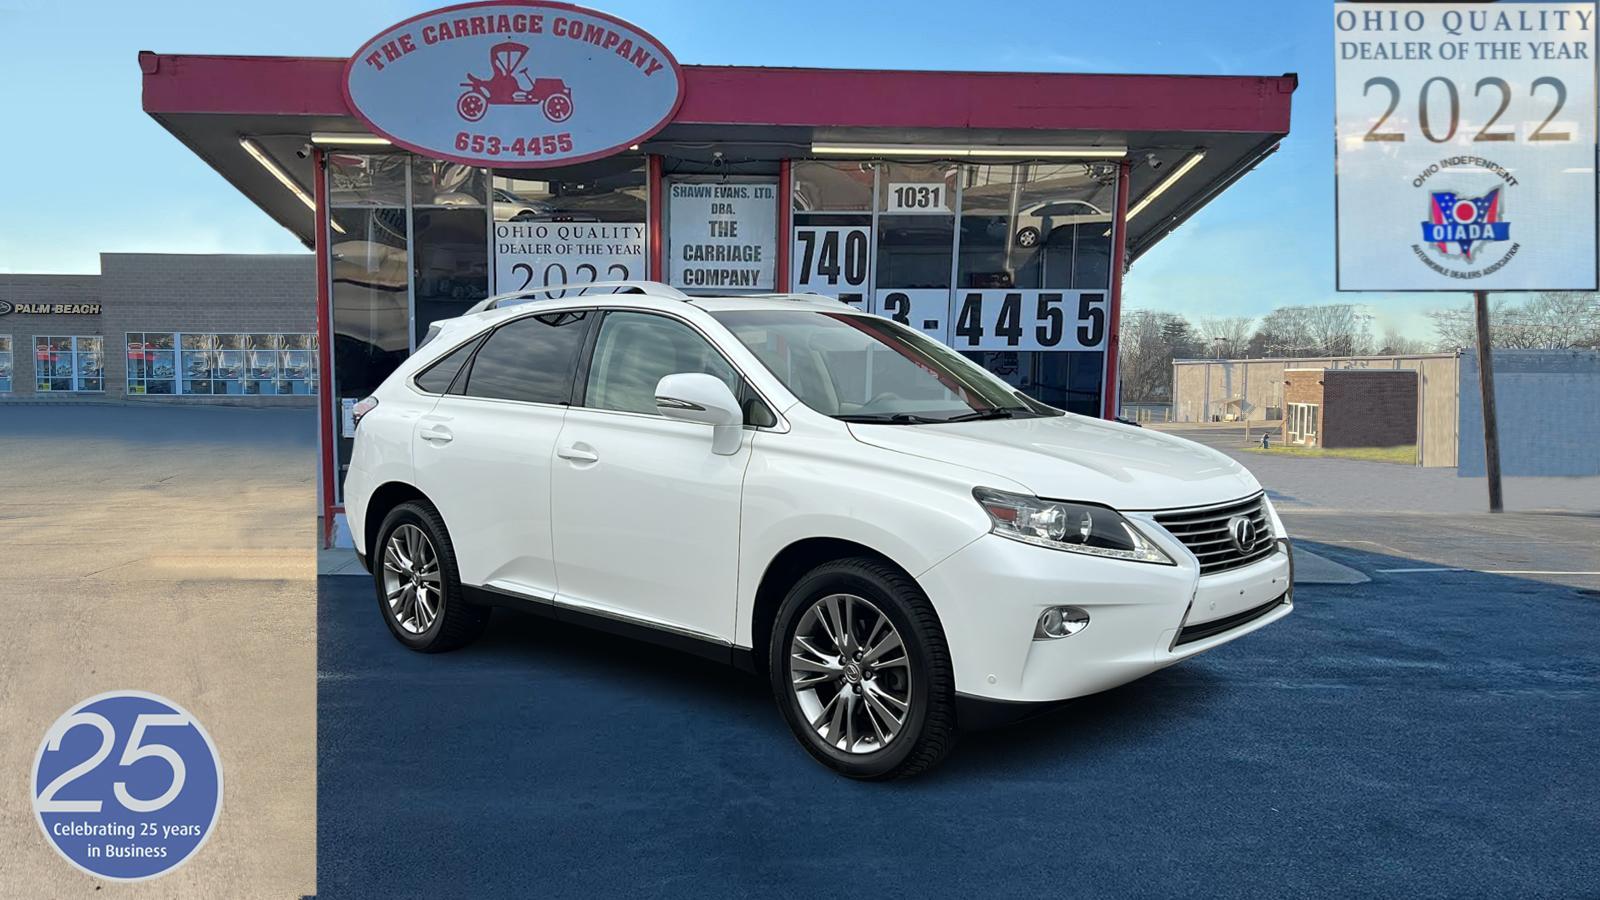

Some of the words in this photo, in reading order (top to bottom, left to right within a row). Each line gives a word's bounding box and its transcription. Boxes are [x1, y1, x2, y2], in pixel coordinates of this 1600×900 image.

[1336, 10, 1425, 31] OHIO
[1442, 10, 1593, 35] QUALITY
[366, 34, 417, 71] THE
[422, 15, 544, 45] CARRIAGE
[552, 17, 664, 77] COMPANY
[1340, 42, 1432, 60] DEALER
[1439, 42, 1469, 60] OF
[1475, 42, 1522, 59] THE
[1528, 42, 1588, 59] YEAR
[1363, 76, 1570, 143] 2022
[455, 132, 573, 156] 653-4455
[1413, 164, 1440, 188] OHIO
[1440, 156, 1519, 187] INDEPENDENT
[672, 187, 712, 199] SHAWN
[754, 187, 775, 199] LTD.
[894, 187, 940, 208] 1031
[711, 203, 736, 215] DBA.
[497, 225, 549, 239] OHIO
[558, 226, 644, 241] QUALITY
[708, 221, 738, 237] THE
[1432, 223, 1495, 240] OIADA
[499, 244, 552, 255] DEALER
[556, 244, 574, 255] OF
[576, 244, 604, 254] THE
[606, 244, 642, 255] YEAR
[683, 245, 762, 262] CARRIAGE
[797, 230, 868, 285] 740
[1450, 270, 1482, 279] DEALERS
[1483, 242, 1521, 276] ASSOCIATION
[683, 269, 760, 286] COMPANY
[14, 303, 51, 314] PALM
[54, 304, 100, 314] BEACH
